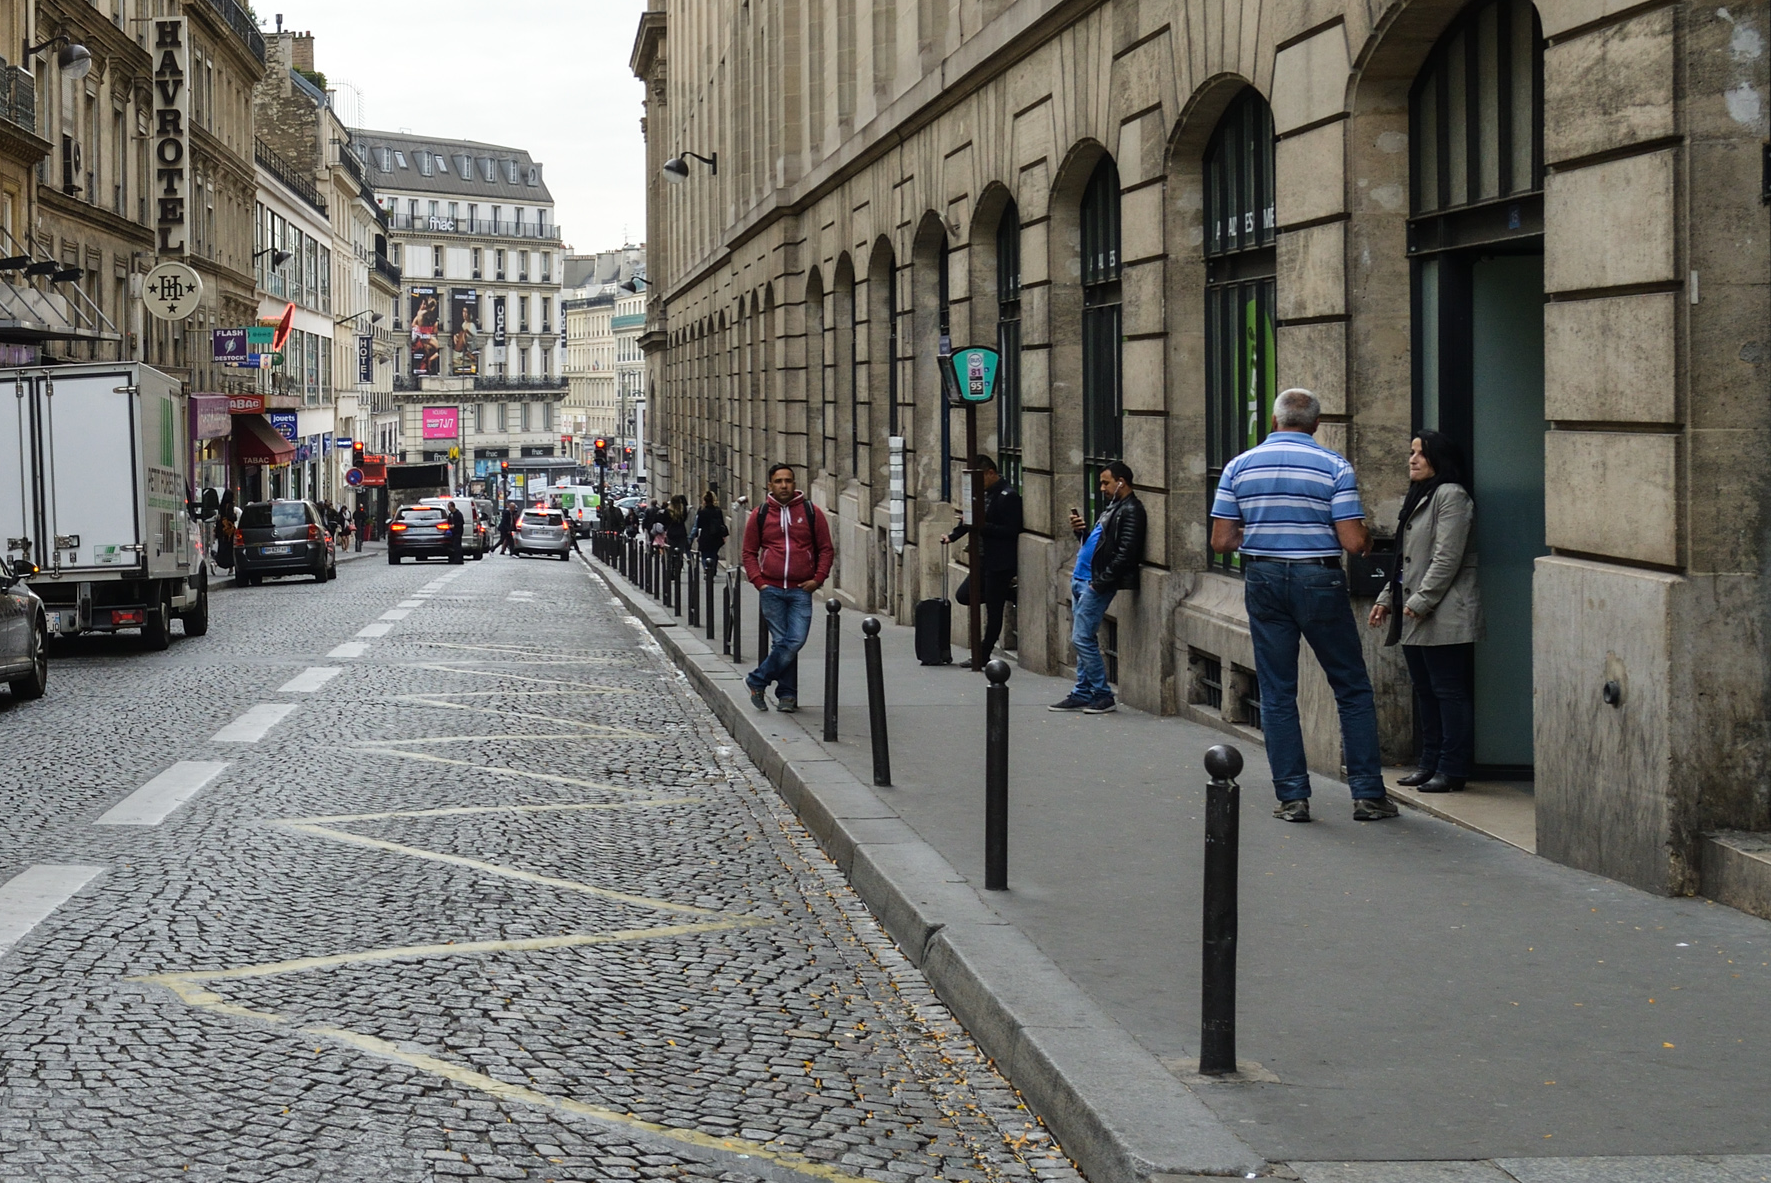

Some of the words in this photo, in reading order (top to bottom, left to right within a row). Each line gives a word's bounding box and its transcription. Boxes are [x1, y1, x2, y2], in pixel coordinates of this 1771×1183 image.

[155, 20, 185, 254] HAVROTEL
[429, 216, 454, 231] fnac
[495, 305, 504, 341] fnac
[970, 368, 981, 376] 81
[970, 382, 982, 391] 95
[229, 399, 259, 409] ABAC
[273, 414, 295, 423] jouets
[449, 446, 459, 459] M
